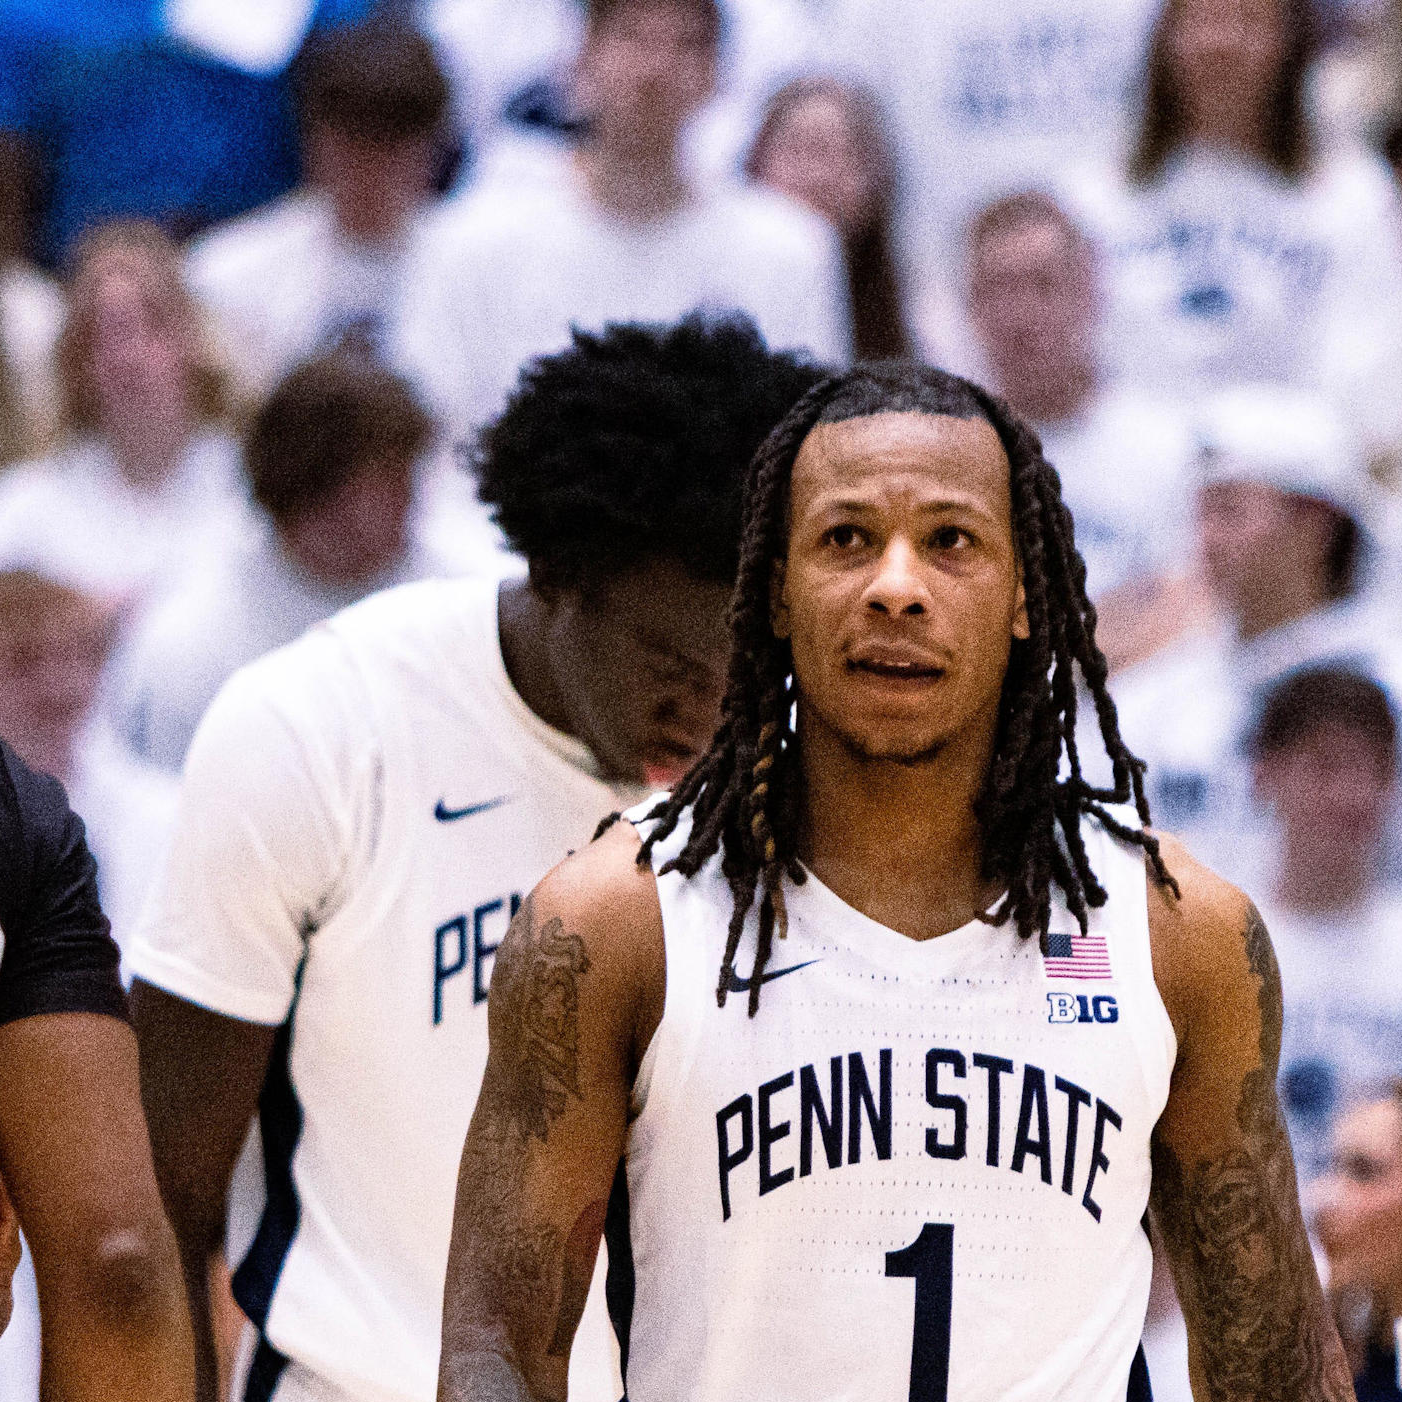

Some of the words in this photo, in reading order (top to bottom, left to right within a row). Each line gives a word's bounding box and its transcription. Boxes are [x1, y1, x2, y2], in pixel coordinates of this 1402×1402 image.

[432, 893, 522, 1027] PE
[715, 1048, 892, 1223] PENN
[925, 1047, 1123, 1224] STATE
